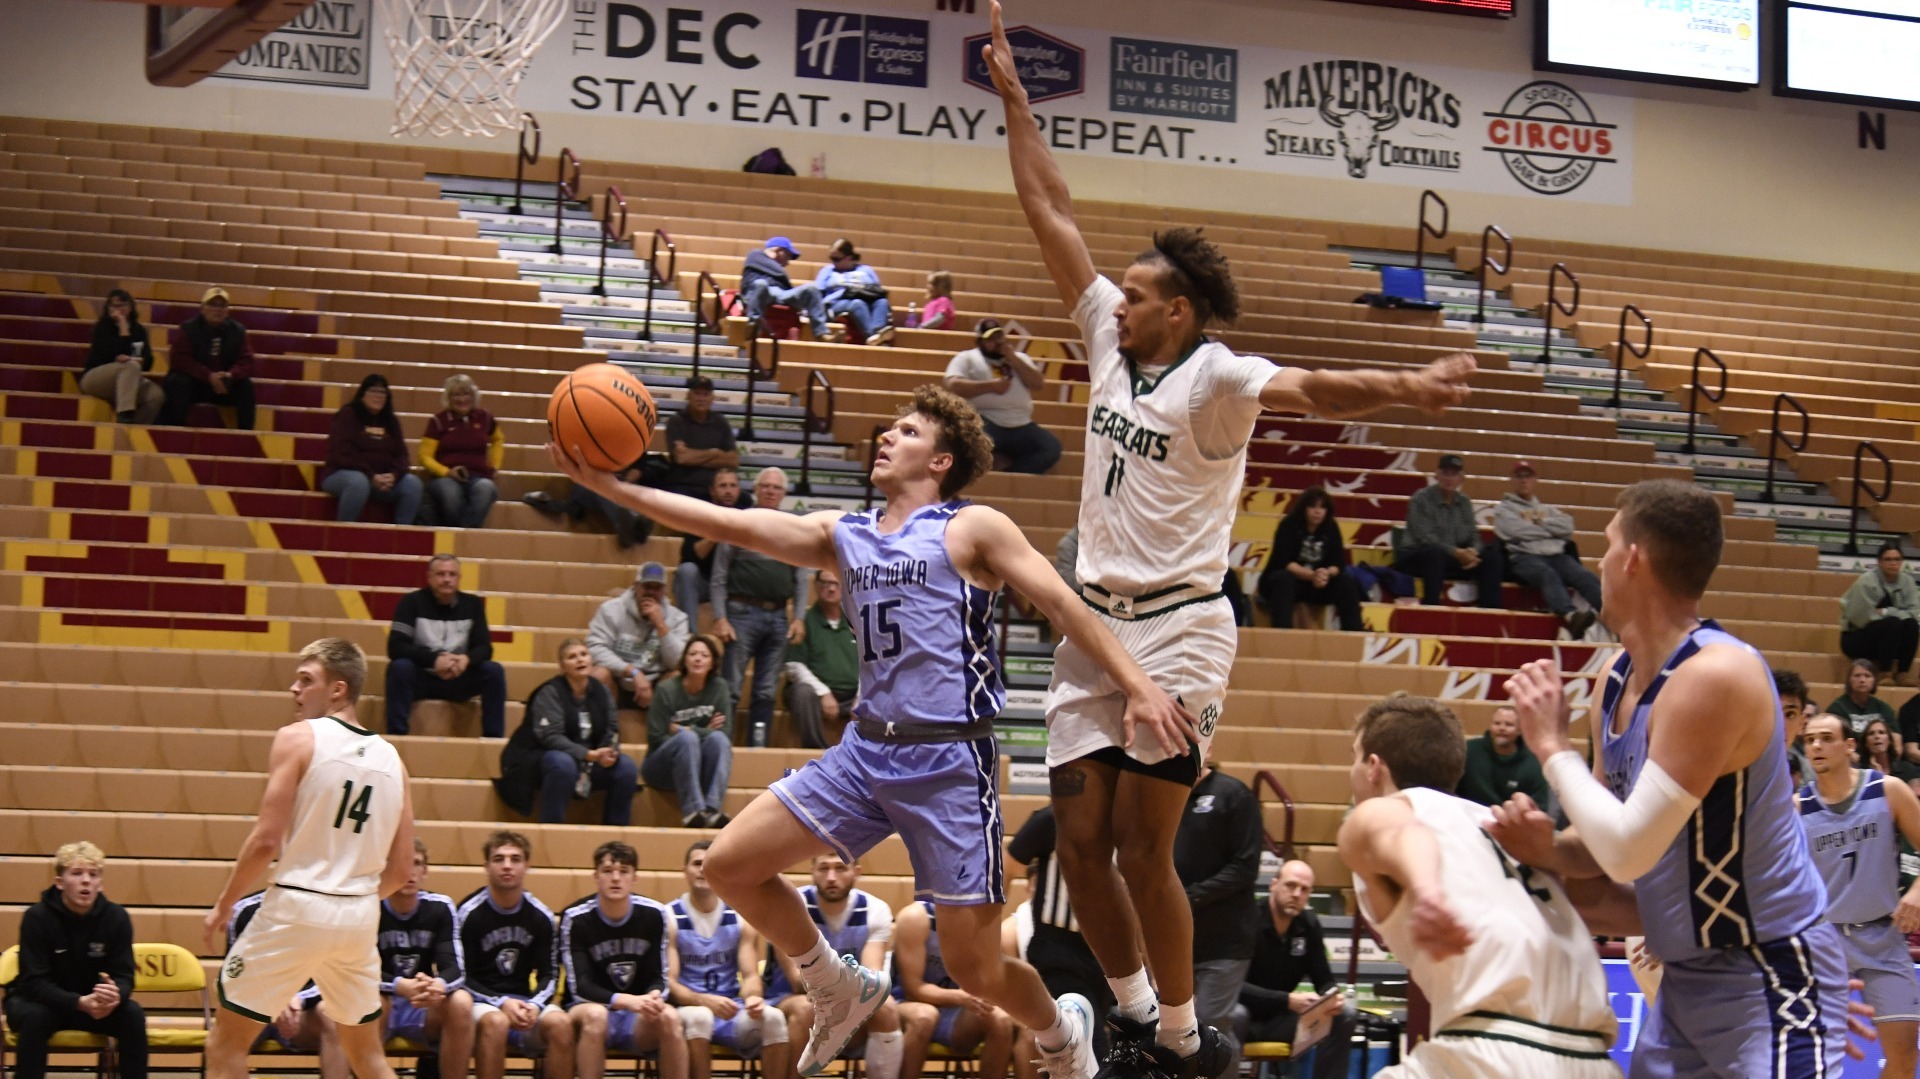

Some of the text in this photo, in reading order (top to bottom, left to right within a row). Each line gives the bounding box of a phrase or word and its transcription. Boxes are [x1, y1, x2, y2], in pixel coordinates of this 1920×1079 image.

[573, 0, 597, 55] THE
[606, 3, 761, 69] DEC
[237, 41, 360, 75] OMPANIES
[868, 43, 924, 62] Express
[1116, 43, 1232, 82] Fairfield
[571, 75, 698, 117] STAY
[732, 88, 830, 128] EAT
[863, 99, 987, 140] PLAY
[1116, 80, 1231, 100] INN & SUITES
[1116, 94, 1230, 115] BY MARRIOTT
[1264, 60, 1461, 128] MAVERICKS
[1524, 87, 1574, 107] SPORTS
[1488, 118, 1612, 155] CIRCUS
[1858, 111, 1886, 150] N
[1510, 157, 1536, 182] BAR
[1090, 403, 1171, 462] EARCATS
[1104, 451, 1126, 498] 11
[886, 559, 928, 588] IOWA
[860, 599, 902, 663] 15
[332, 779, 374, 835] 14
[1813, 830, 1847, 852] UPPER
[1842, 850, 1857, 880] 7
